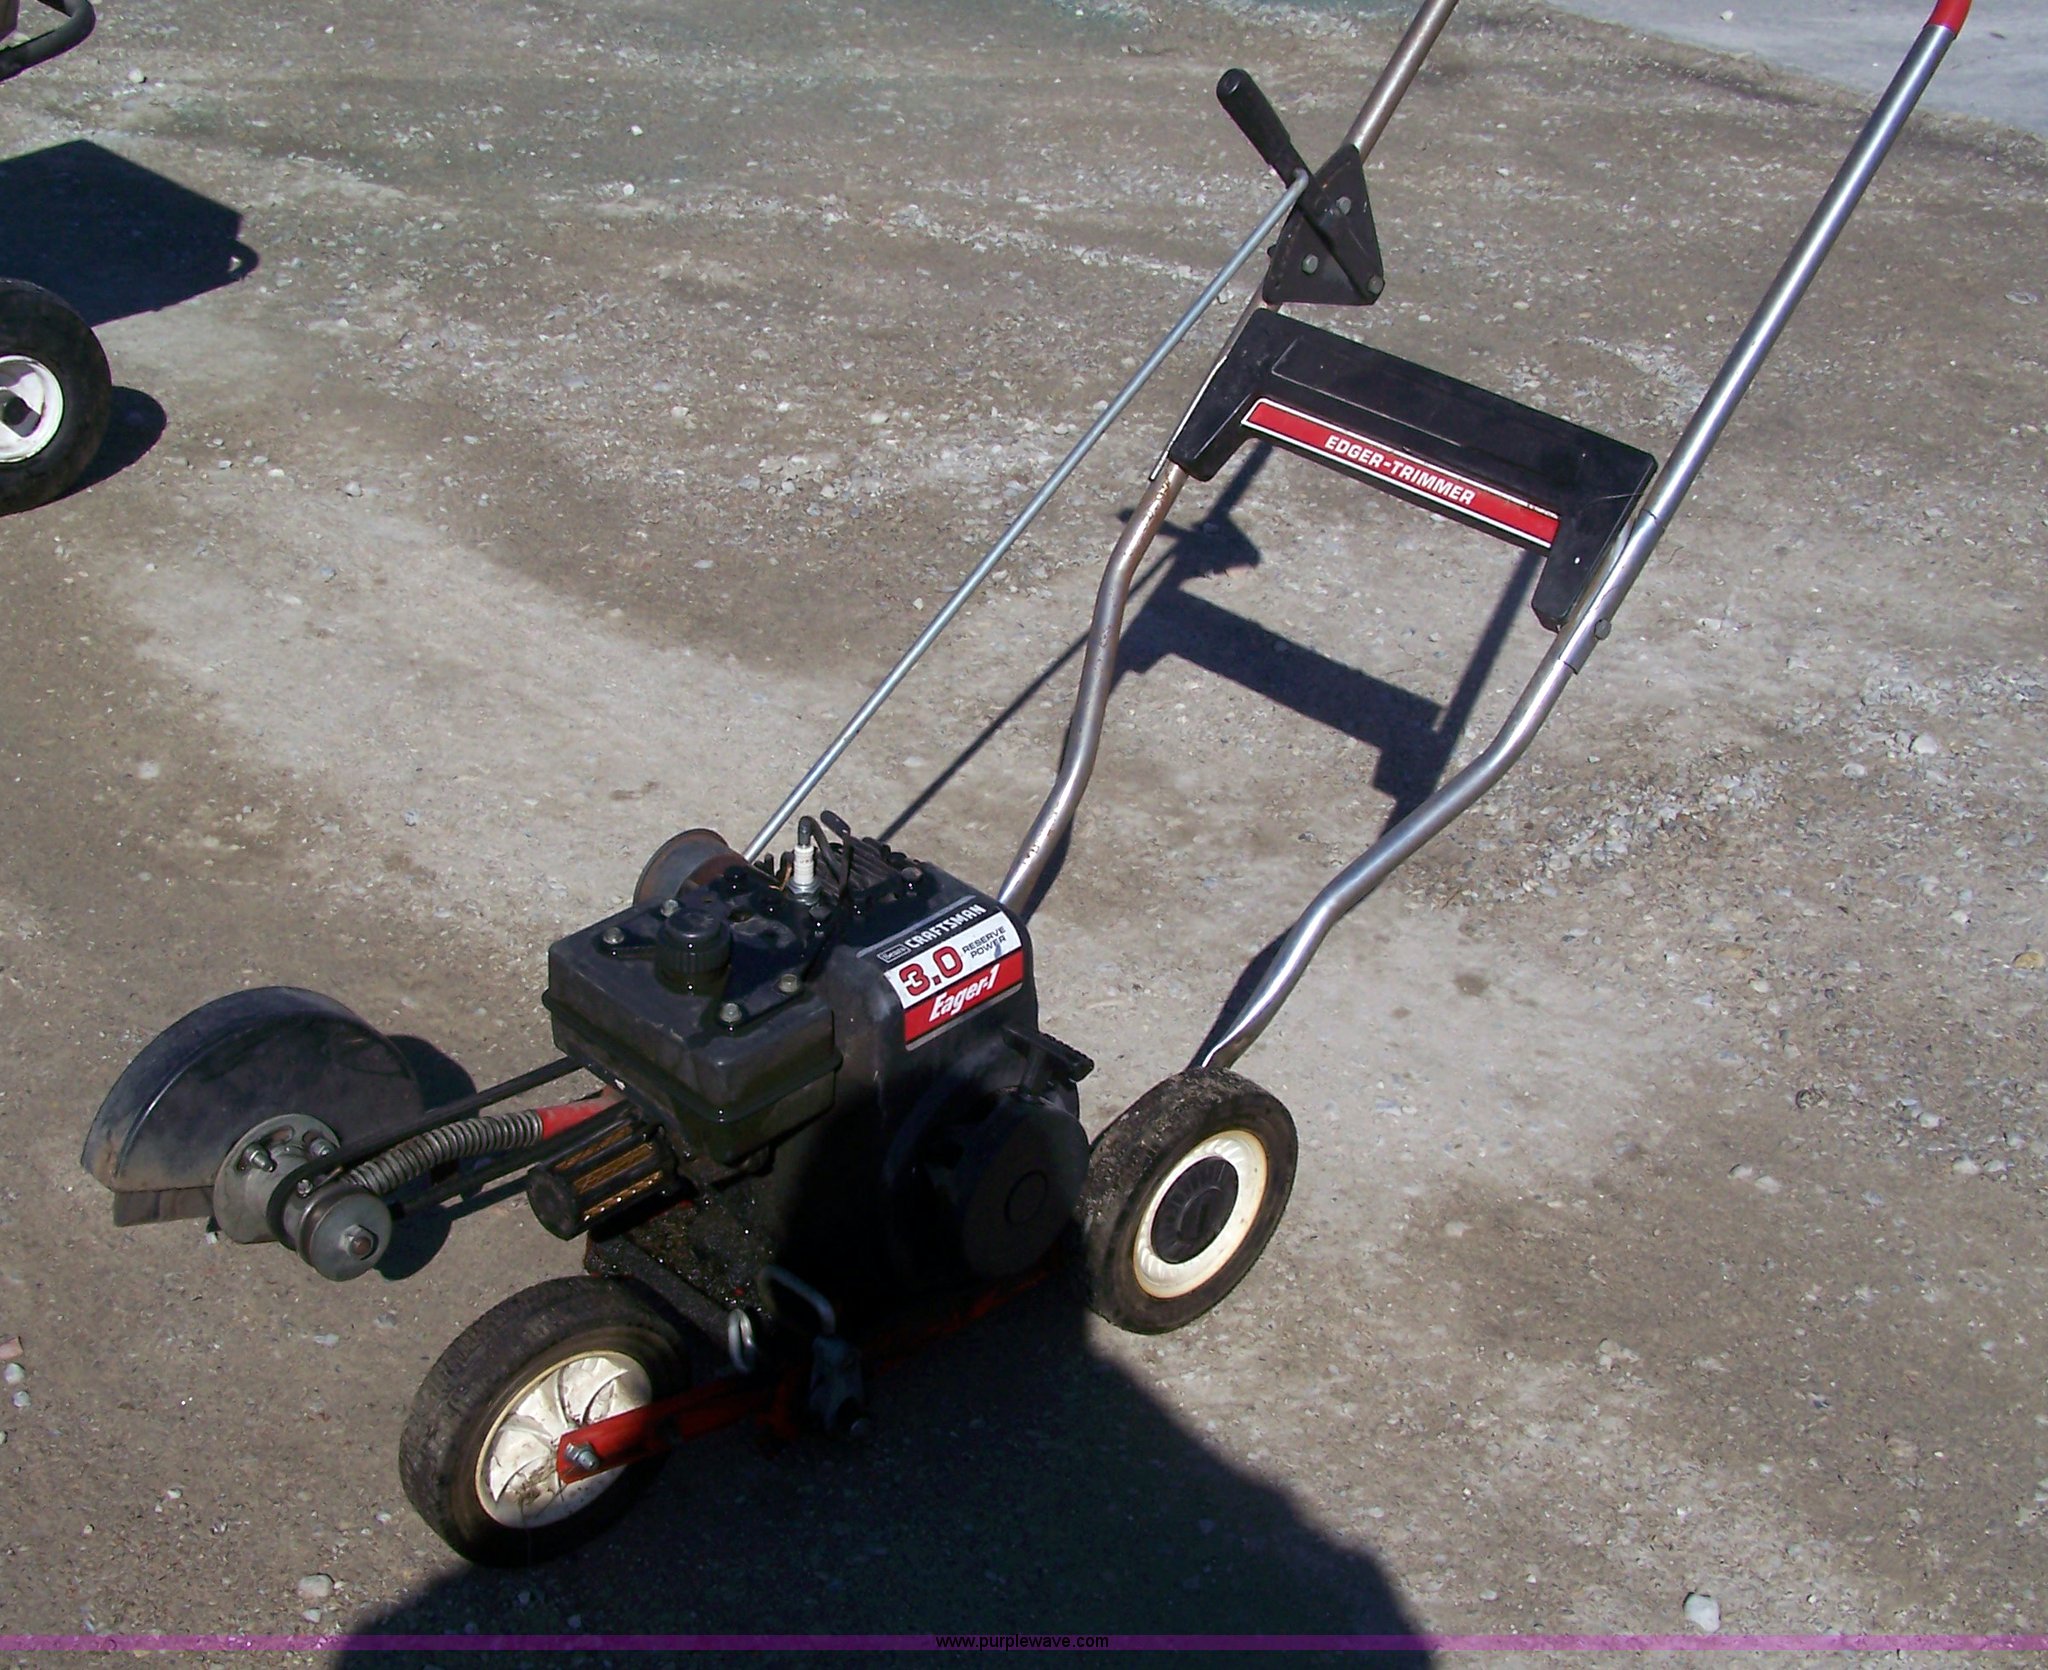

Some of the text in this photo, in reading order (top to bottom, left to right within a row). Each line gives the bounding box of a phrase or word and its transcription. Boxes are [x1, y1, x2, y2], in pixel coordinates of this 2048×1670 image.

[1325, 435, 1476, 505] EDGER-TRIMMER
[904, 904, 987, 948] CRAFTSMAN
[962, 926, 1006, 953] RESERVE
[971, 936, 1006, 958] POWER
[899, 946, 963, 996] 3.0
[929, 963, 1000, 1022] Eager-1
